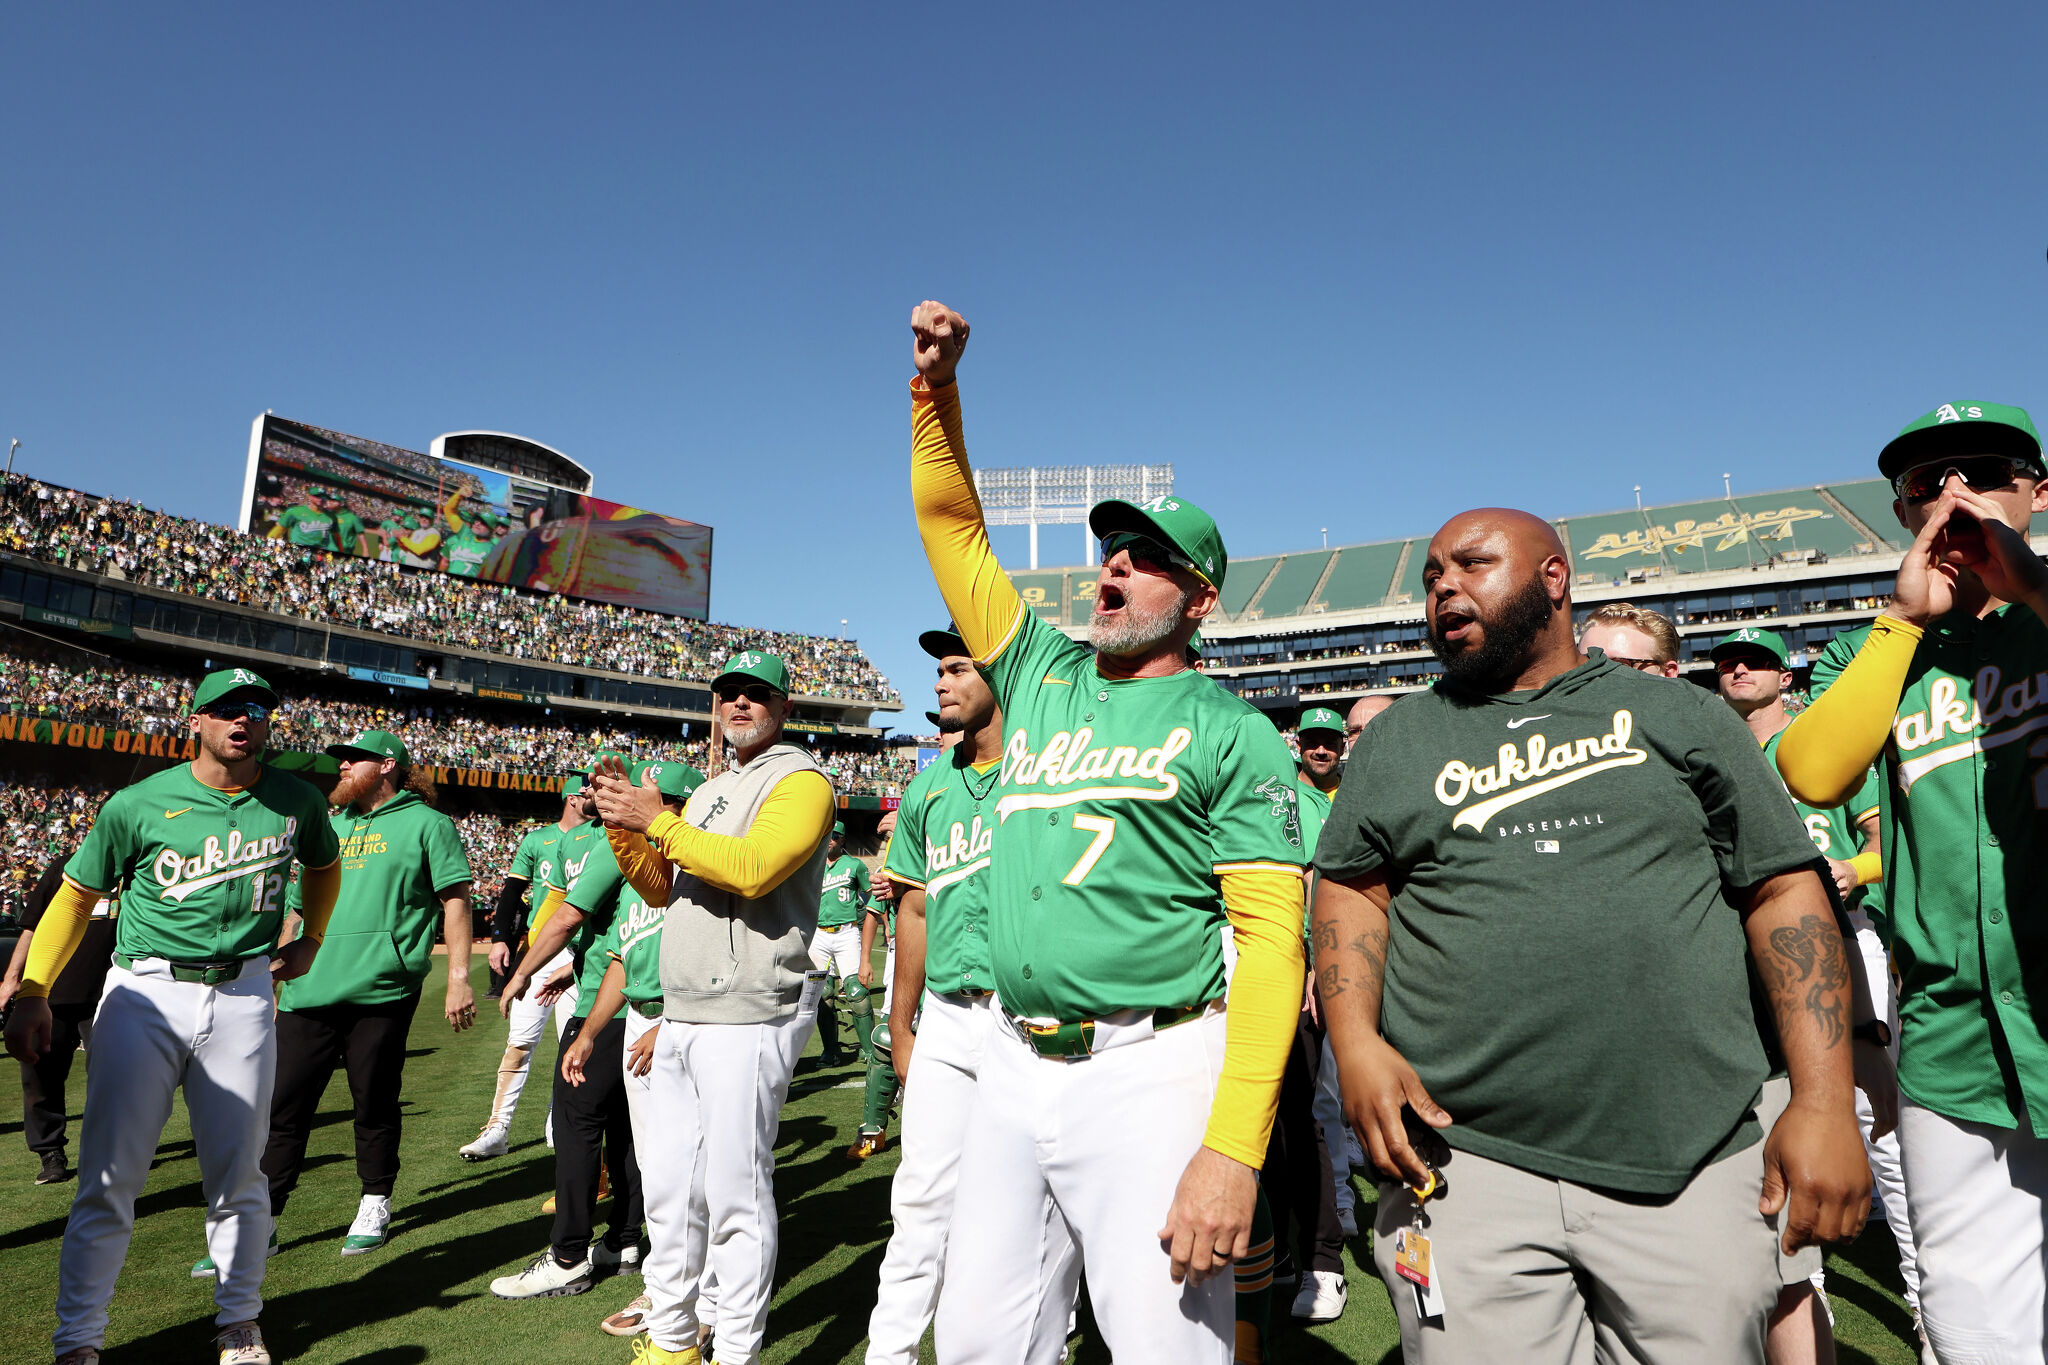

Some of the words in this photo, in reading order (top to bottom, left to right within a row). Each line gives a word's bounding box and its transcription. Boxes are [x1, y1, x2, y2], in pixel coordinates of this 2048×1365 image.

[1936, 403, 1983, 424] A's
[1140, 495, 1180, 512] A's
[1579, 507, 1823, 558] Athletics
[1022, 587, 1046, 603] 9
[43, 612, 65, 624] LET'S
[67, 618, 78, 627] GO
[1733, 628, 1760, 642] A's
[733, 651, 762, 671] A's
[229, 668, 257, 684] A's
[373, 671, 406, 685] Corona
[1312, 709, 1331, 722] A's
[1892, 665, 2048, 751] akla
[783, 722, 833, 733] ATHLETICS.COM
[51, 721, 105, 750] YOU
[114, 729, 197, 760] OAKLA
[1000, 727, 1193, 788] Oakland
[1434, 709, 1634, 806] Oakland
[424, 765, 450, 784] NK
[456, 768, 492, 788] YOU
[1499, 815, 1604, 837] BASEBALL
[1803, 813, 1831, 853] 6
[153, 816, 298, 888] Oakland
[1061, 813, 1116, 886] 7
[251, 872, 283, 912] 12
